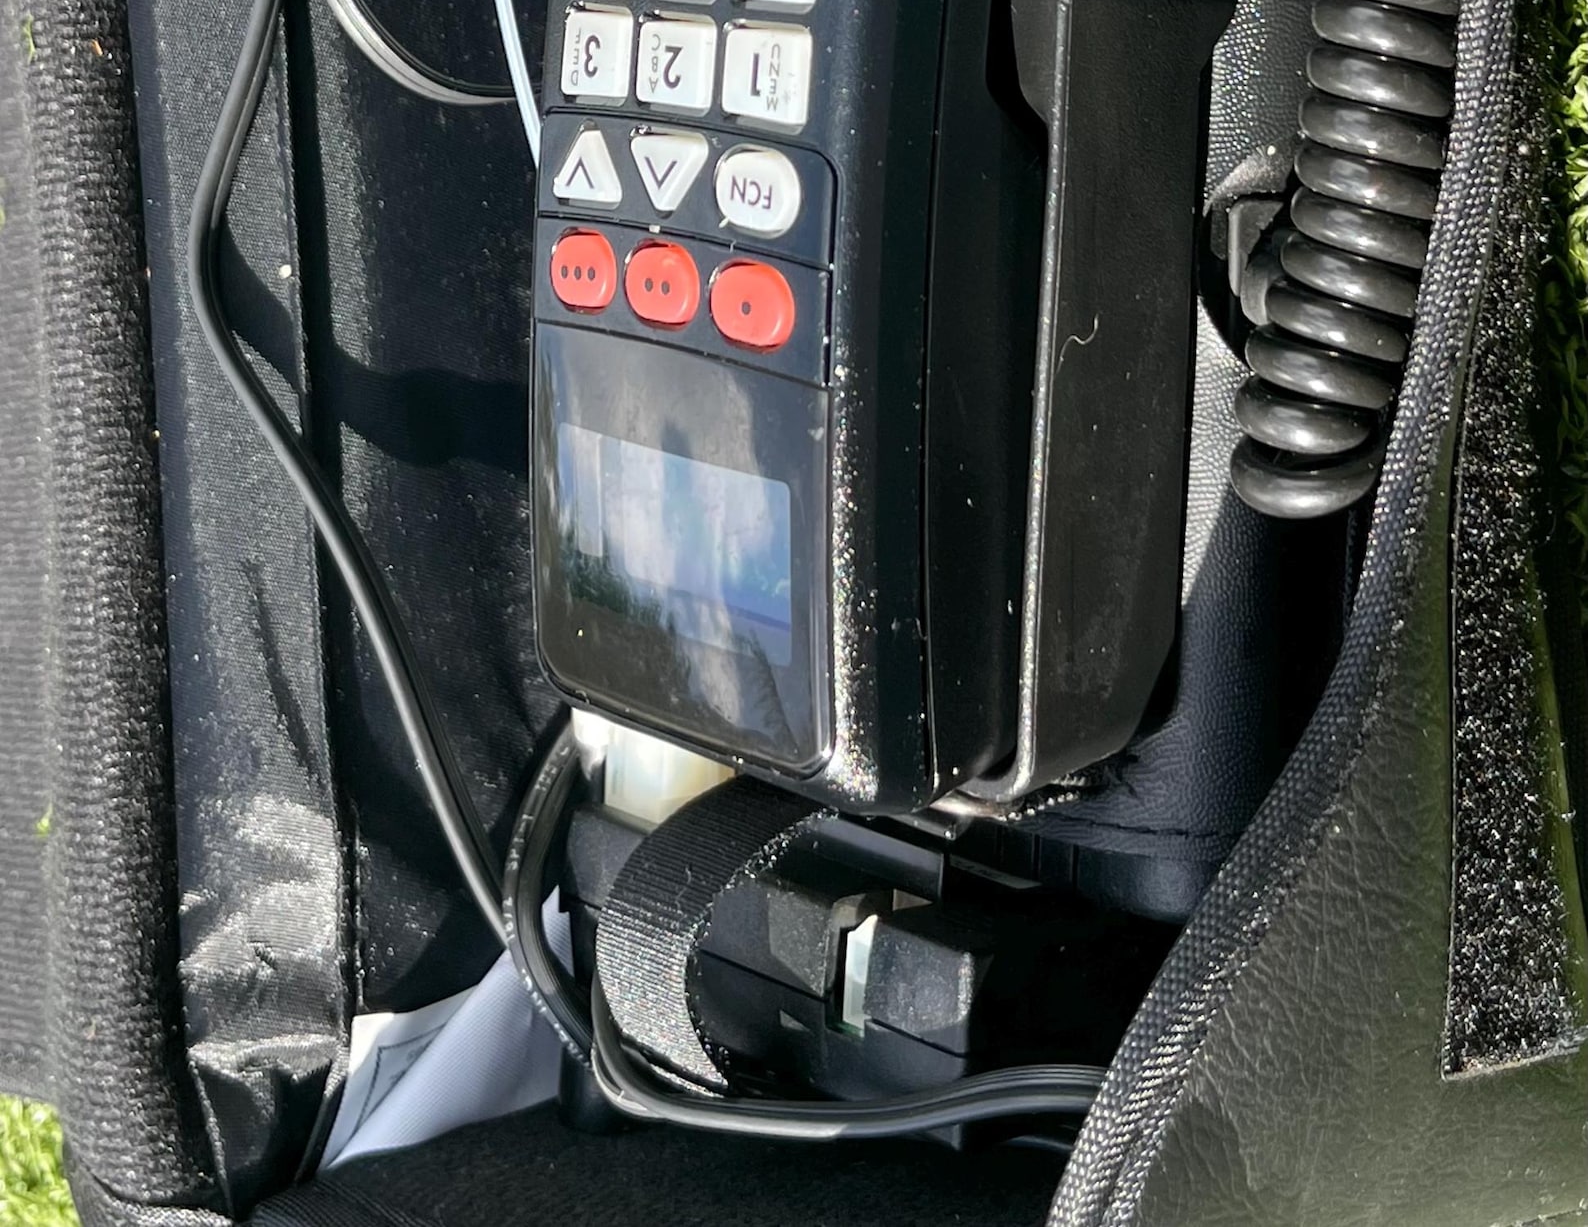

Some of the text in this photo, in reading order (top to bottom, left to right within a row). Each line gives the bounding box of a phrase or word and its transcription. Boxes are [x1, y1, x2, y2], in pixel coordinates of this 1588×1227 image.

[583, 34, 600, 77] 3
[662, 45, 682, 88] 2
[750, 52, 761, 96] 1
[729, 174, 771, 209] FCN
